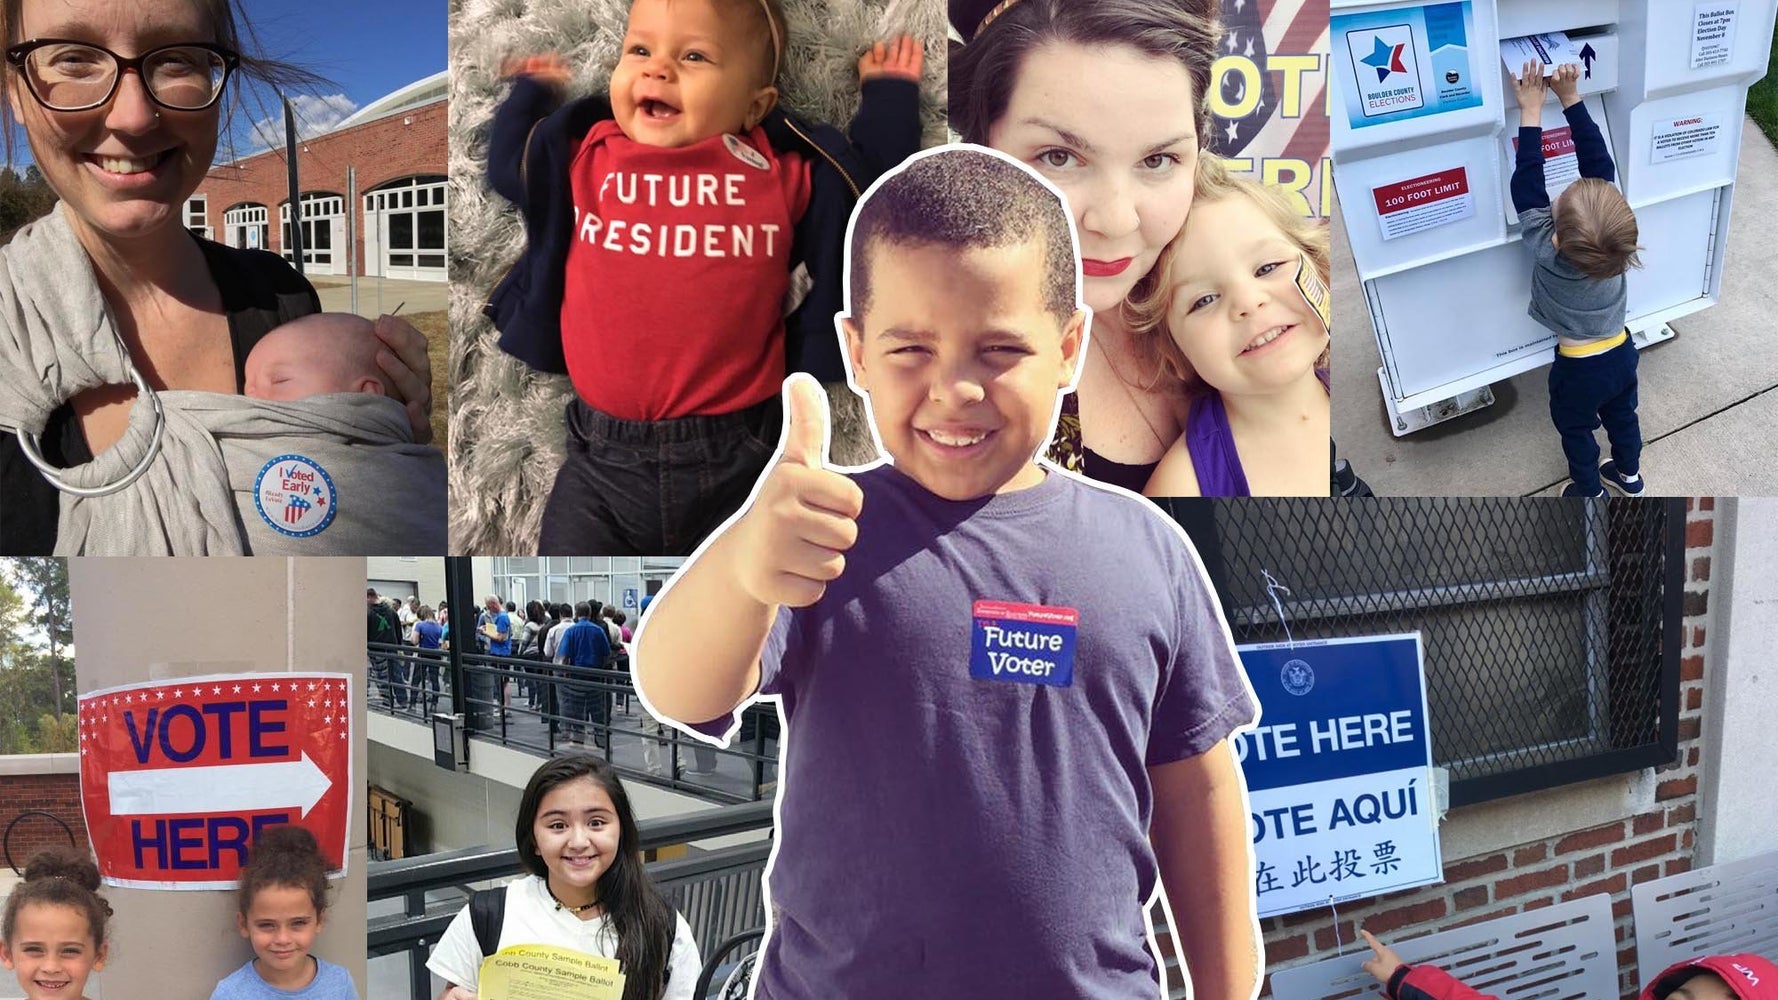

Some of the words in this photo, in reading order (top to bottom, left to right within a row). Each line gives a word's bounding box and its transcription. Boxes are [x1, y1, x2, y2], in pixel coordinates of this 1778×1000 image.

[1210, 53, 1330, 118] OT
[1367, 90, 1393, 100] BOULDER
[1393, 87, 1414, 96] COUNTY
[1369, 94, 1416, 108] ELECTIONS
[1562, 139, 1575, 148] LIM
[599, 172, 746, 207] FUTURE
[1385, 196, 1405, 207] 100
[1407, 189, 1432, 201] FOOT
[1435, 182, 1460, 194] LIMIT
[279, 467, 283, 477] I
[286, 464, 314, 482] Voted
[282, 479, 310, 495] Early
[984, 626, 1063, 652] Future
[987, 652, 1055, 676] Voter
[124, 700, 289, 764] VOTE
[1235, 723, 1300, 762] TE
[1309, 710, 1414, 754] HERE
[1252, 803, 1317, 844] TE
[1328, 778, 1418, 831] AQUÍ
[1256, 840, 1402, 897] 在此投票
[496, 960, 519, 968] Cobb
[522, 962, 552, 974] County
[555, 968, 586, 982] Sample
[589, 976, 614, 987] Ballot
[519, 950, 549, 959] County
[551, 953, 582, 967] Sample
[585, 960, 608, 972] Ballot
